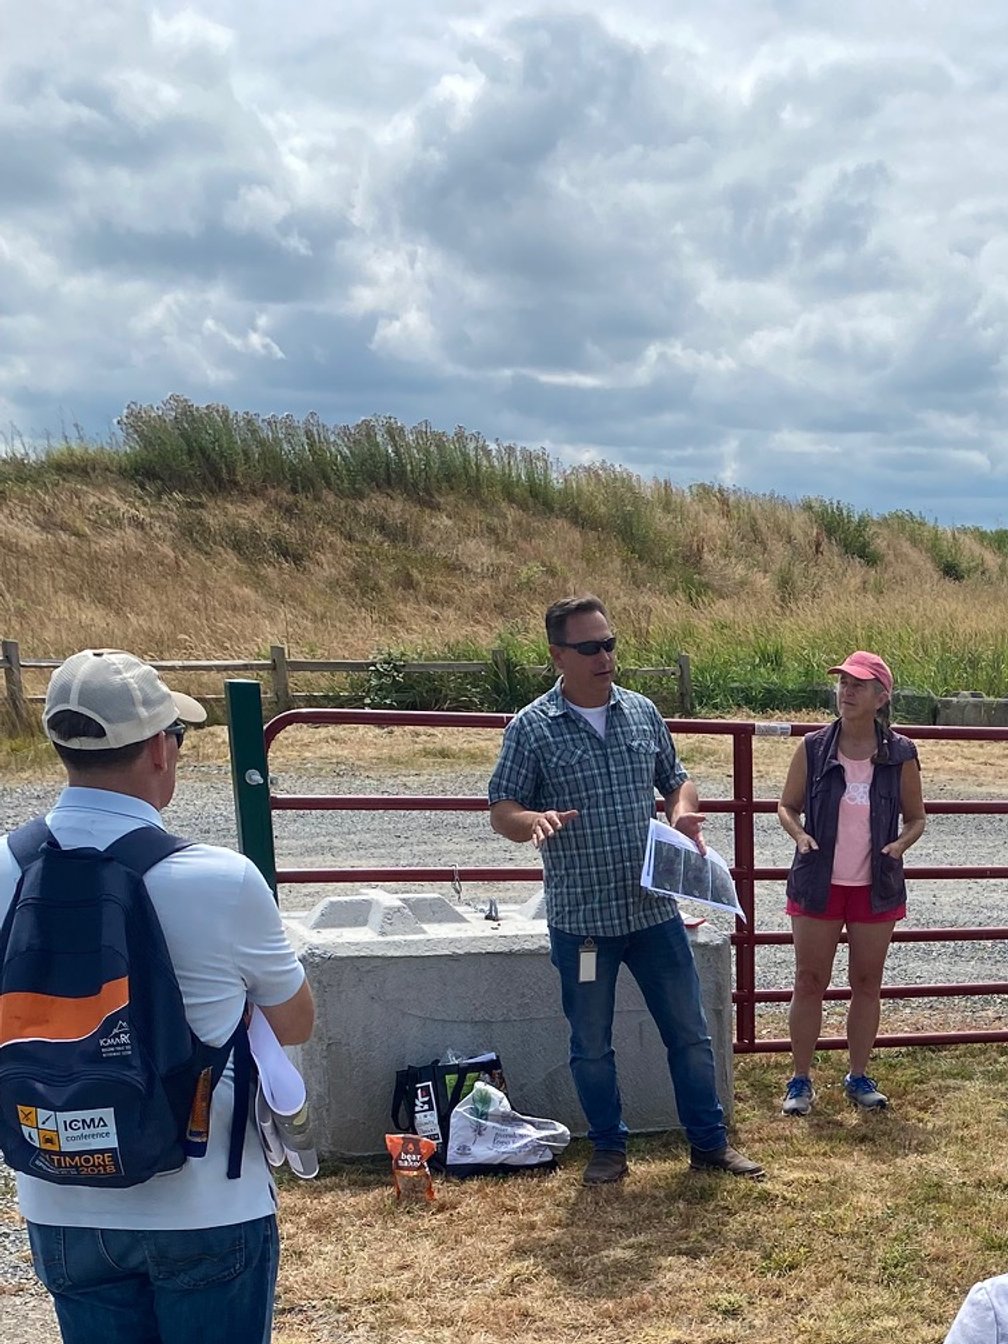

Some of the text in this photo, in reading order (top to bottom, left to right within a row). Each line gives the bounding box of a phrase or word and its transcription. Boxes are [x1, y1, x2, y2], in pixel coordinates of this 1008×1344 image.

[63, 1117, 109, 1131] ICMA
[65, 1130, 111, 1142] conference
[401, 1152, 421, 1161] bear
[80, 1165, 116, 1175] 2018
